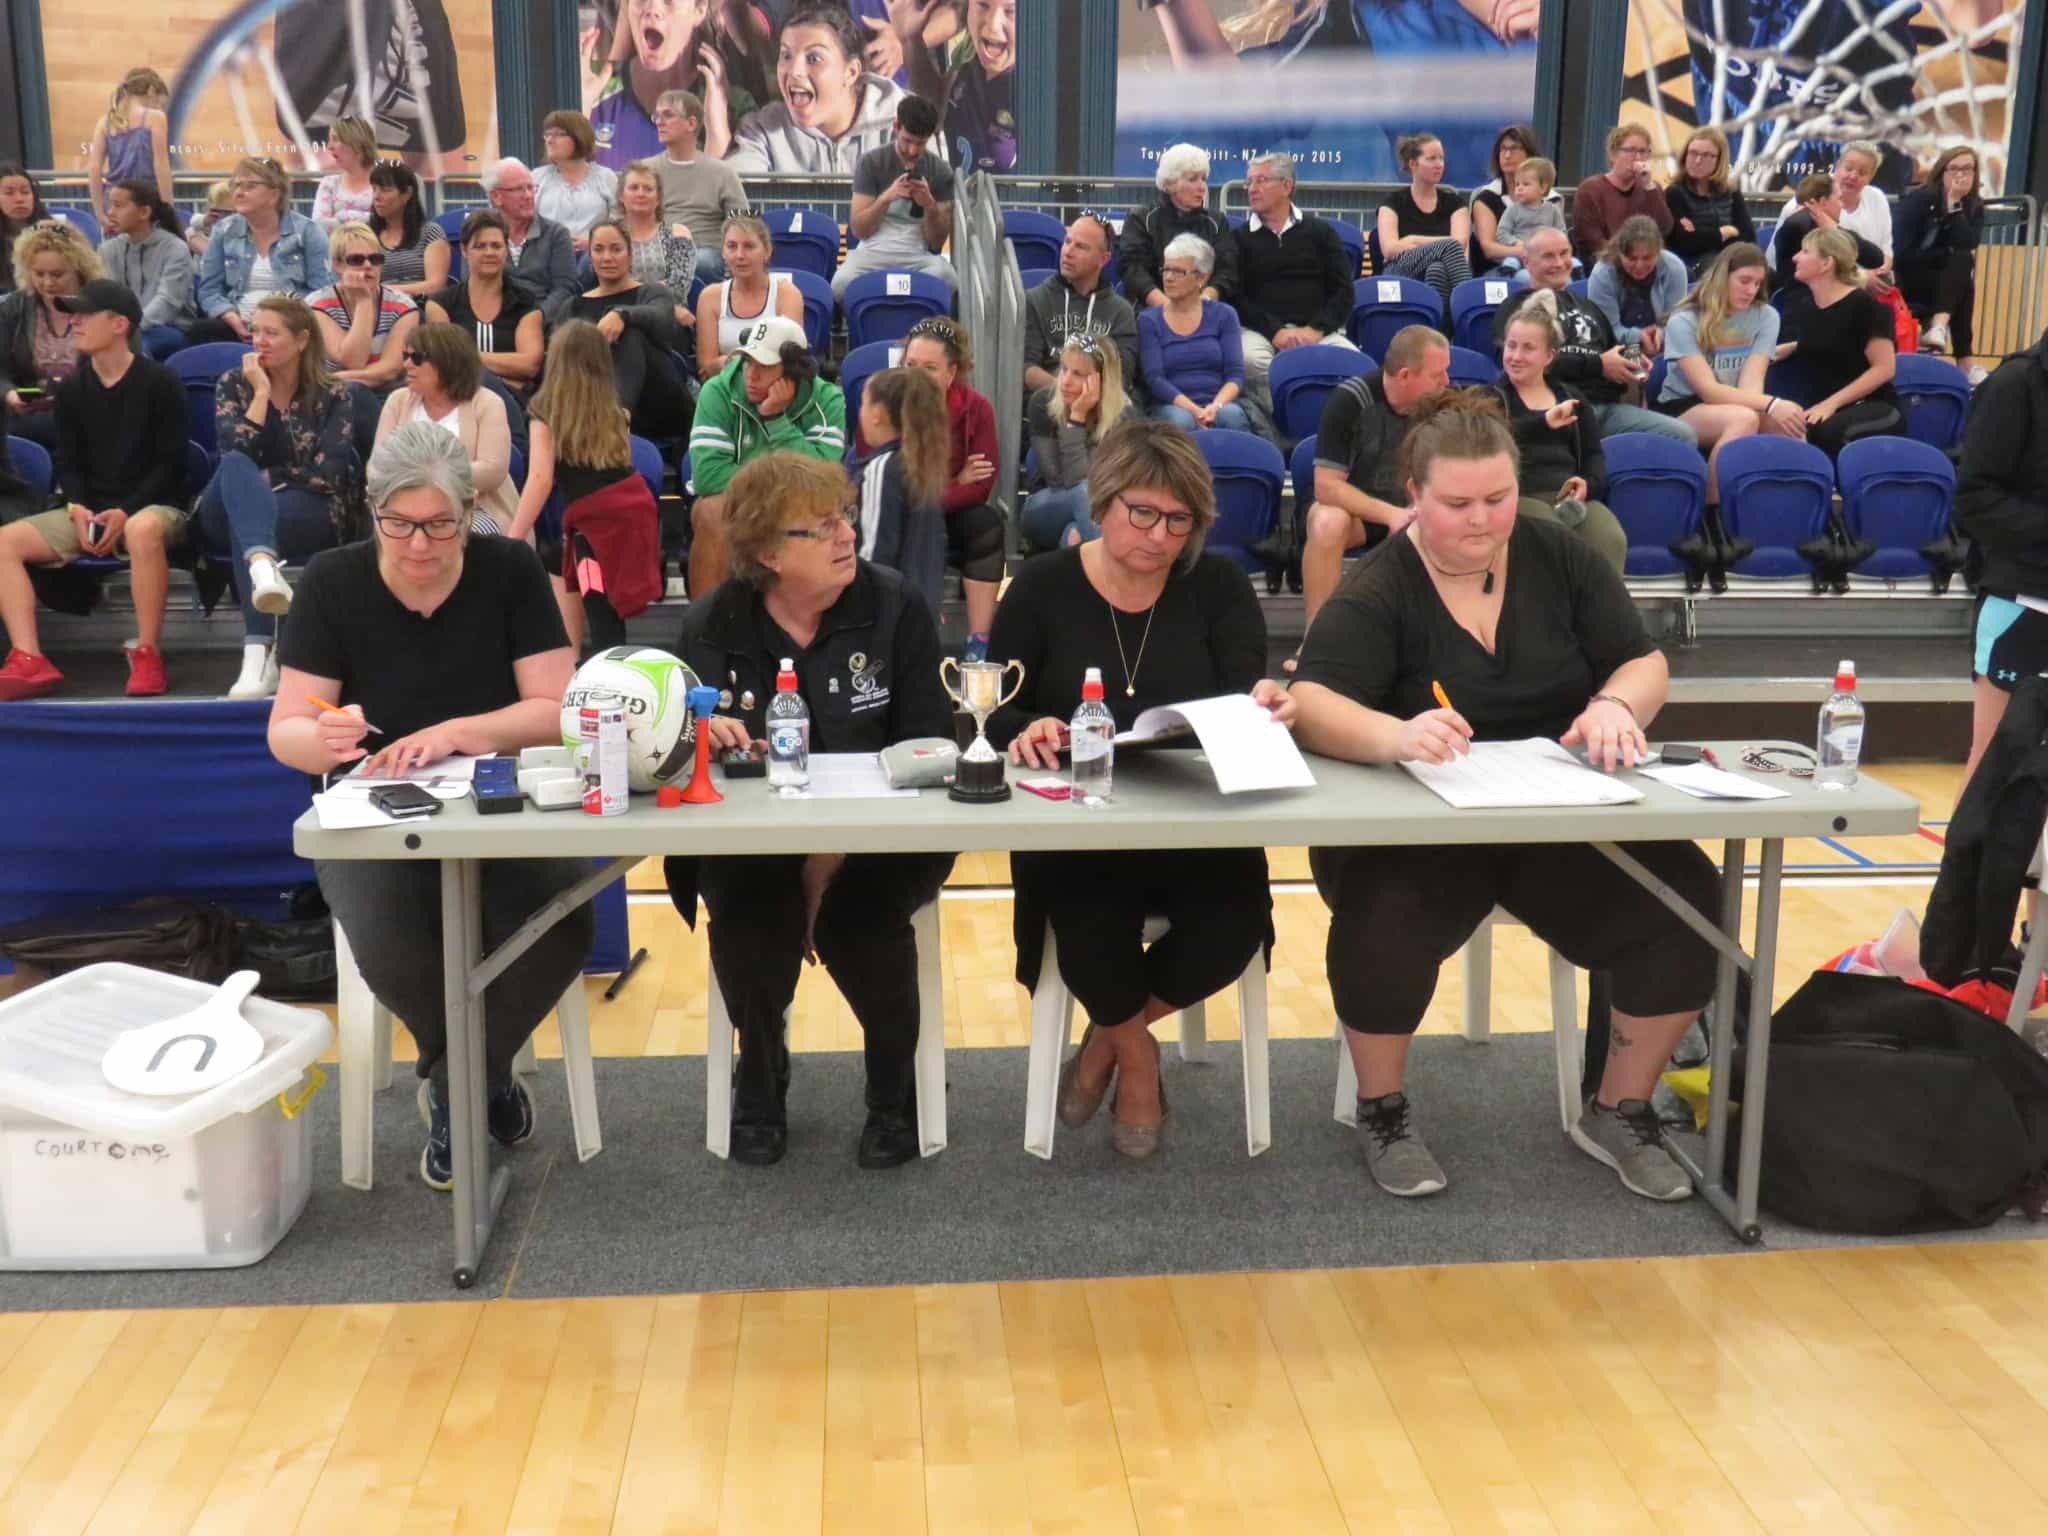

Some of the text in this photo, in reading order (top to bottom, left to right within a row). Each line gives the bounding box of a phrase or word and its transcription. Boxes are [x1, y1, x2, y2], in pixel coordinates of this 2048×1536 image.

[1241, 150, 1257, 161] NZ
[1311, 151, 1342, 163] 2015
[1786, 162, 1814, 175] 1993
[897, 279, 909, 292] 10
[754, 323, 768, 341] B
